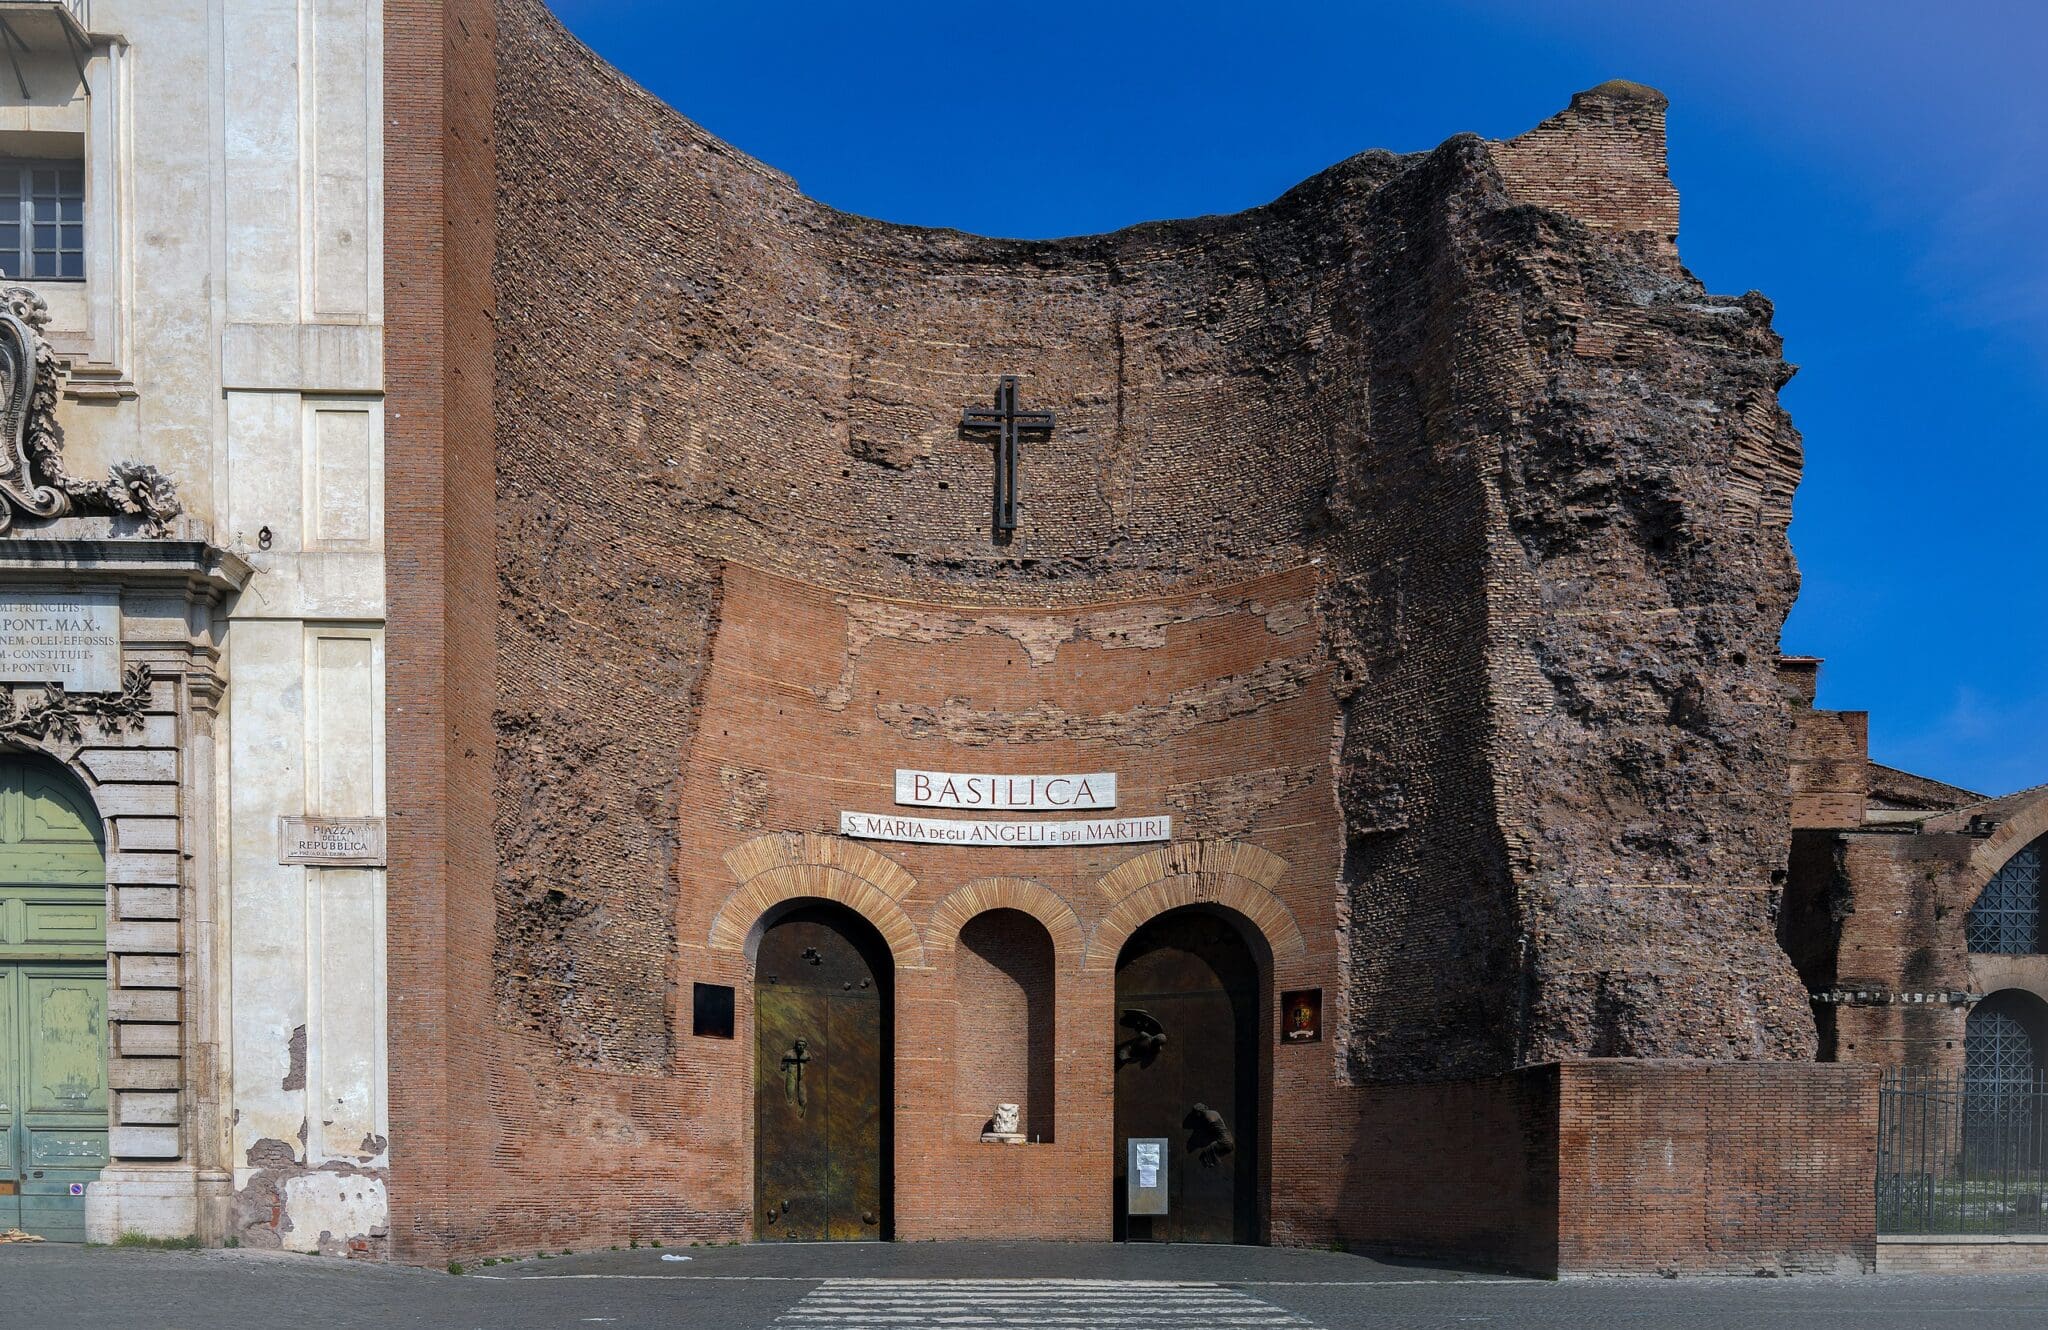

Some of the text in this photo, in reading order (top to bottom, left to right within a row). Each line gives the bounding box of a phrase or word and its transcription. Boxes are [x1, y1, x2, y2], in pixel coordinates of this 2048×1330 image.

[3, 618, 94, 632] PONT MAX
[913, 774, 1097, 806] BASILICA
[313, 825, 355, 835] PIAZZA
[847, 816, 1162, 842] S. MARIA DEGLI ANGELI E DEI MARTIRI
[299, 840, 368, 851] REPUBBLICA
